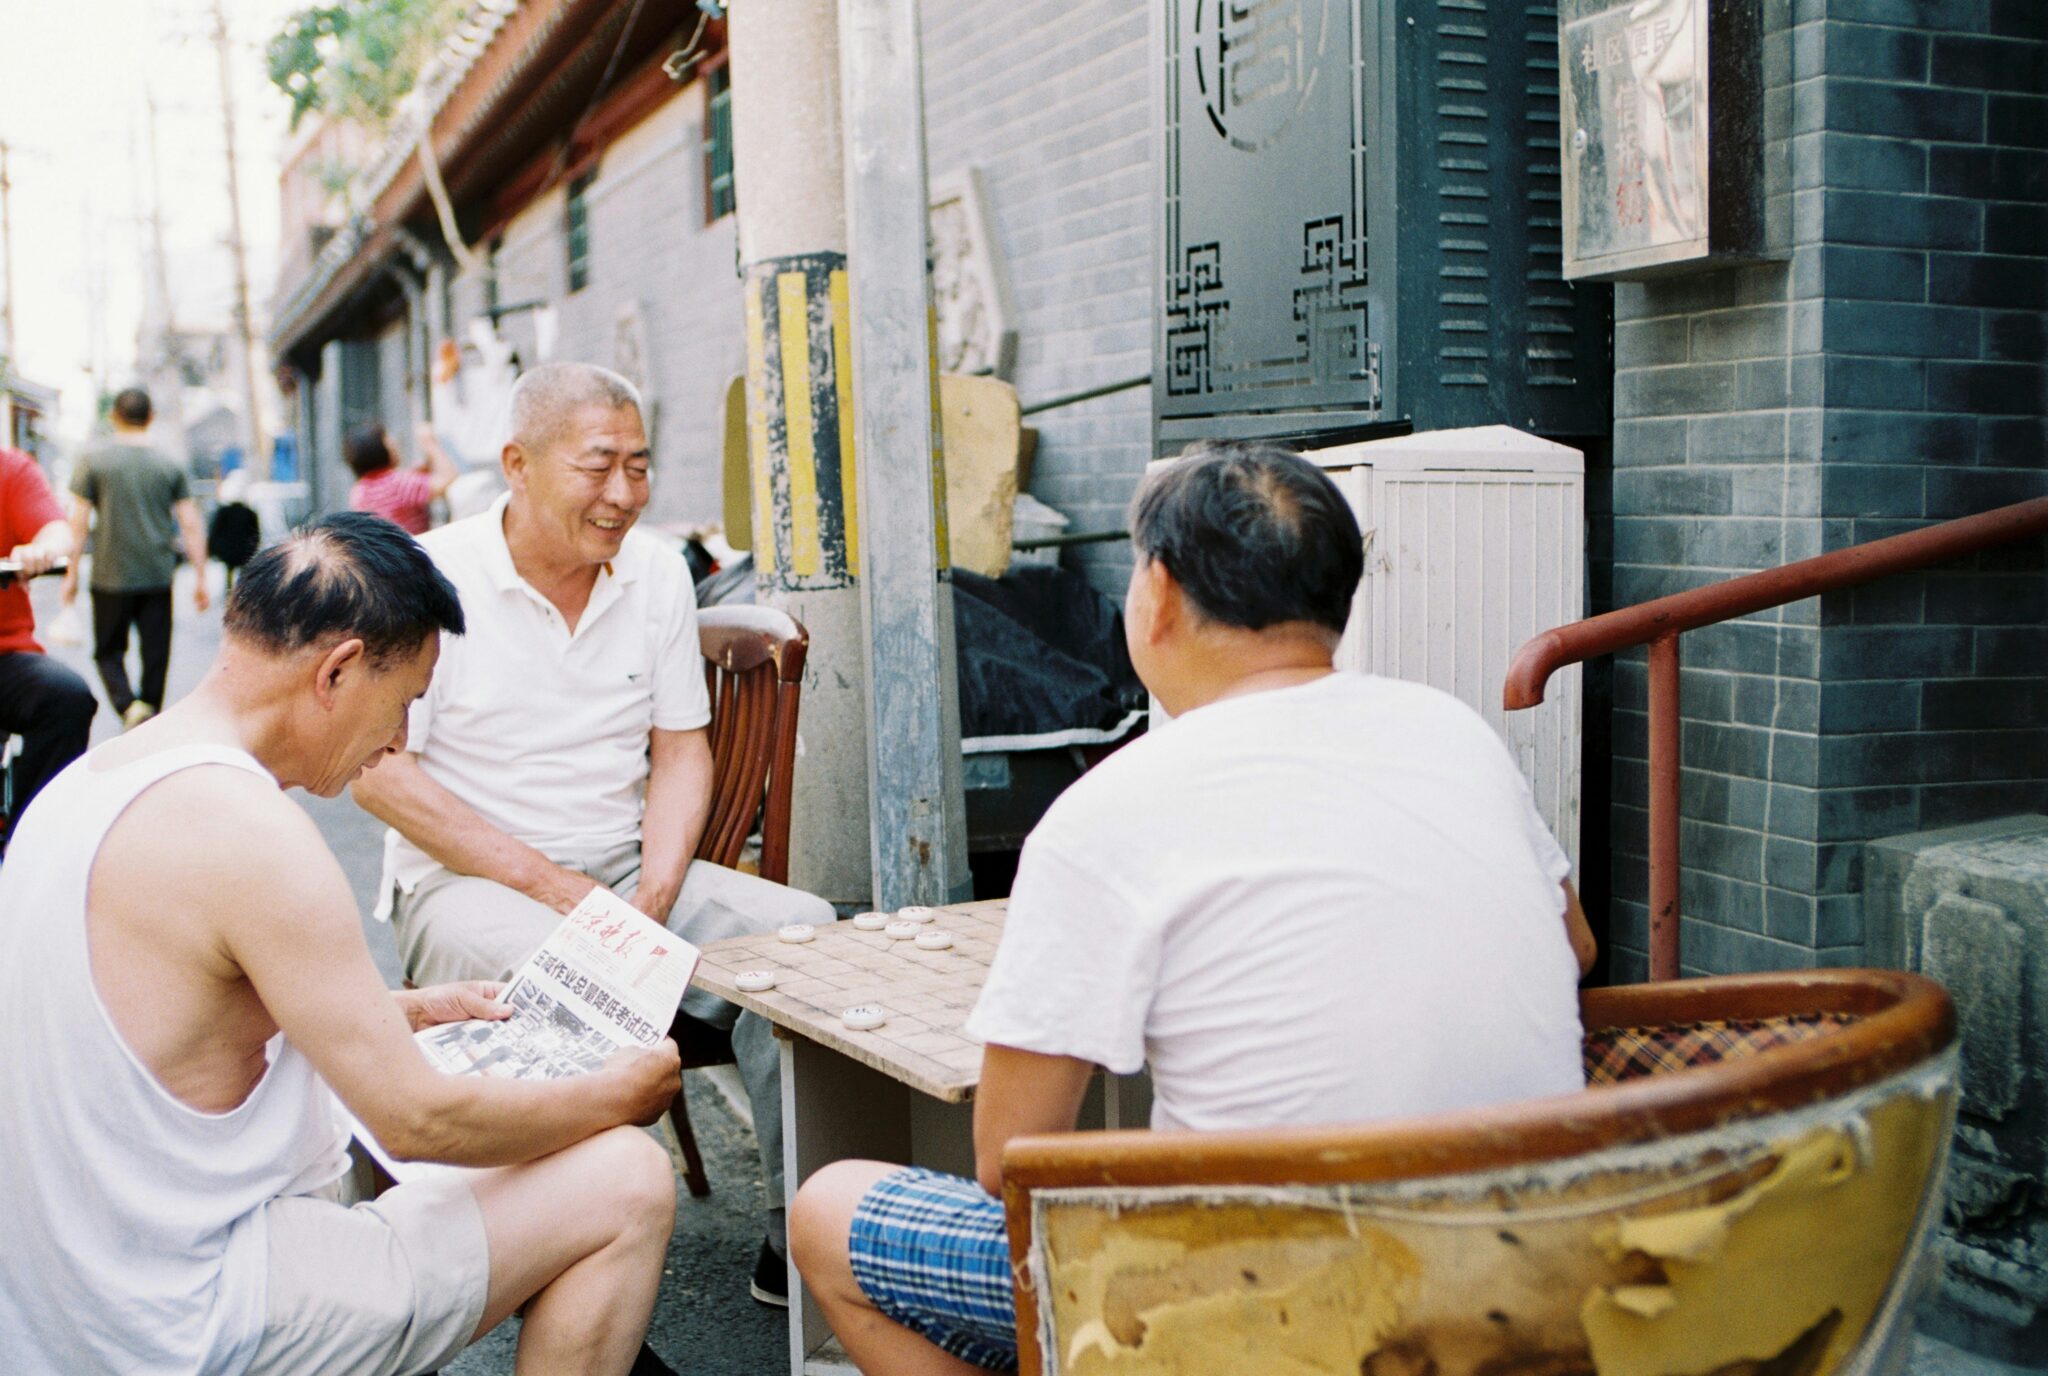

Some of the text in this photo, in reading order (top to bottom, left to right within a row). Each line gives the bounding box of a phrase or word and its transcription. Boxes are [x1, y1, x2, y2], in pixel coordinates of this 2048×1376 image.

[1582, 19, 1673, 73] 社区便民
[571, 903, 647, 960] 北京晚报
[532, 949, 661, 1047] 压减作业总量降低考试压力
